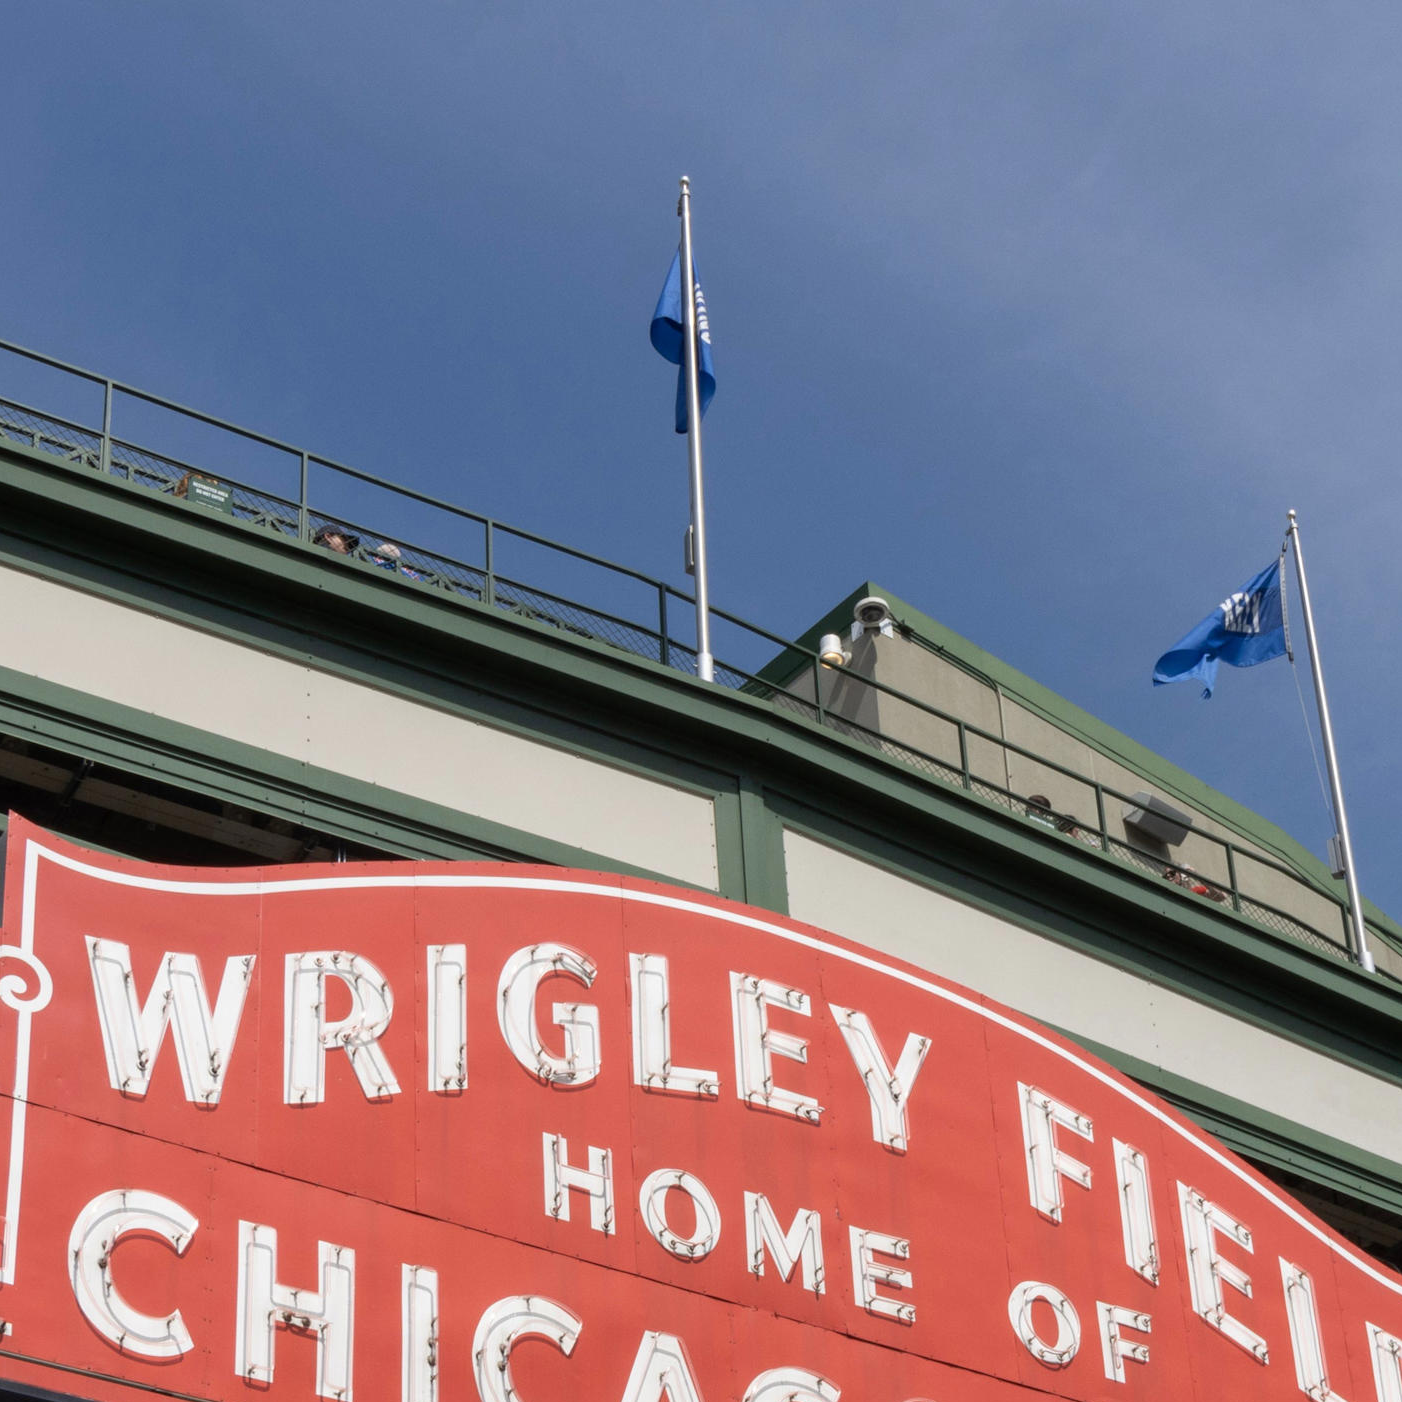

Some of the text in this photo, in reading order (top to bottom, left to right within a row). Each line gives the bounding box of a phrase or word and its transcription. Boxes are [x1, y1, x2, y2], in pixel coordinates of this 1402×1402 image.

[84, 934, 932, 1152] WRIGLEY
[542, 1132, 1153, 1384] HOME OF
